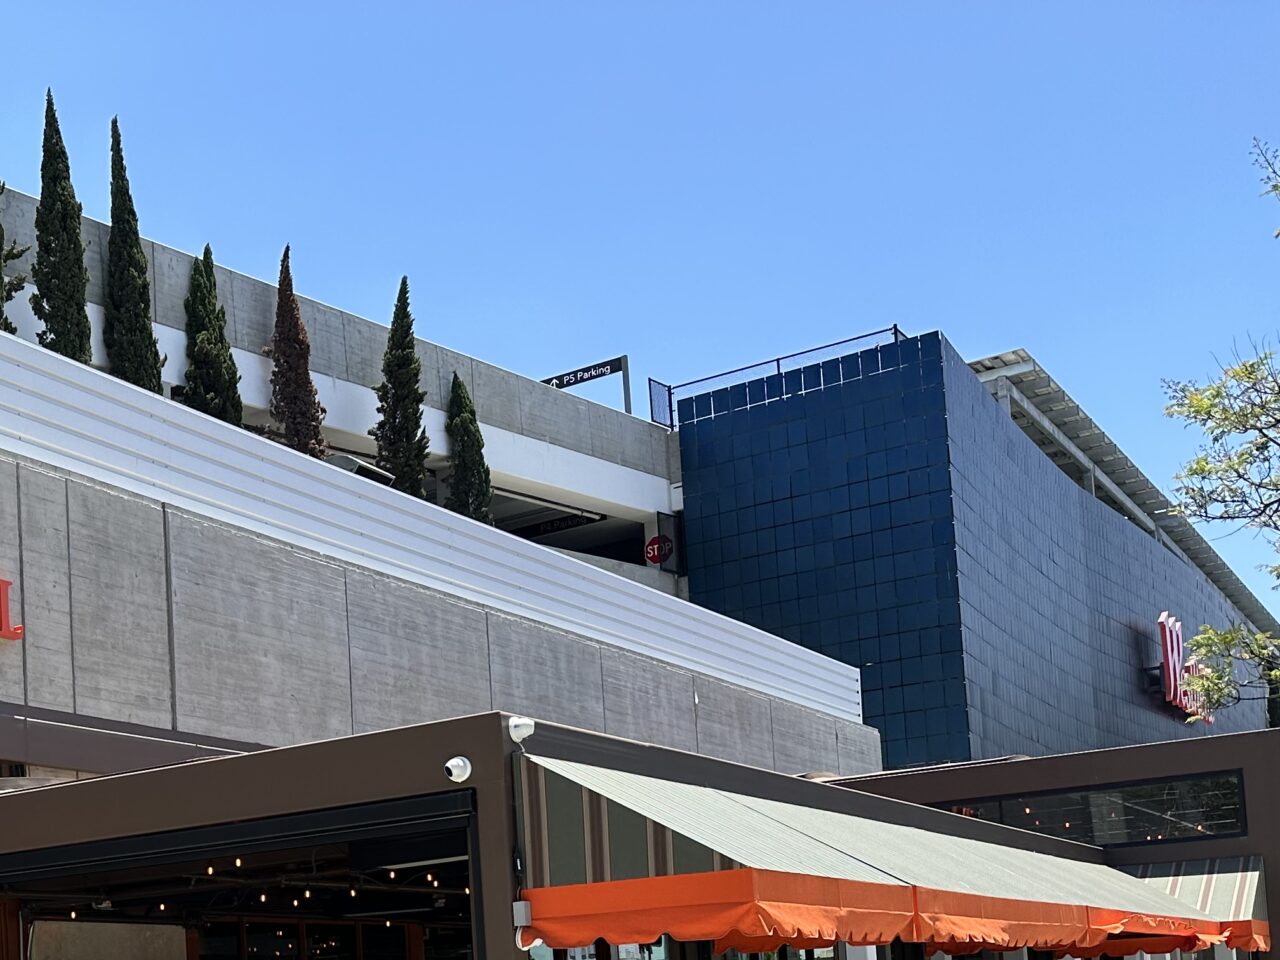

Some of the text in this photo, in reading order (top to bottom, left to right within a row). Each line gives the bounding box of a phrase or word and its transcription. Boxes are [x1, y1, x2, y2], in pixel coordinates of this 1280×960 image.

[563, 365, 611, 385] P5 Parking
[553, 516, 587, 529] Parking
[647, 542, 672, 558] STOP
